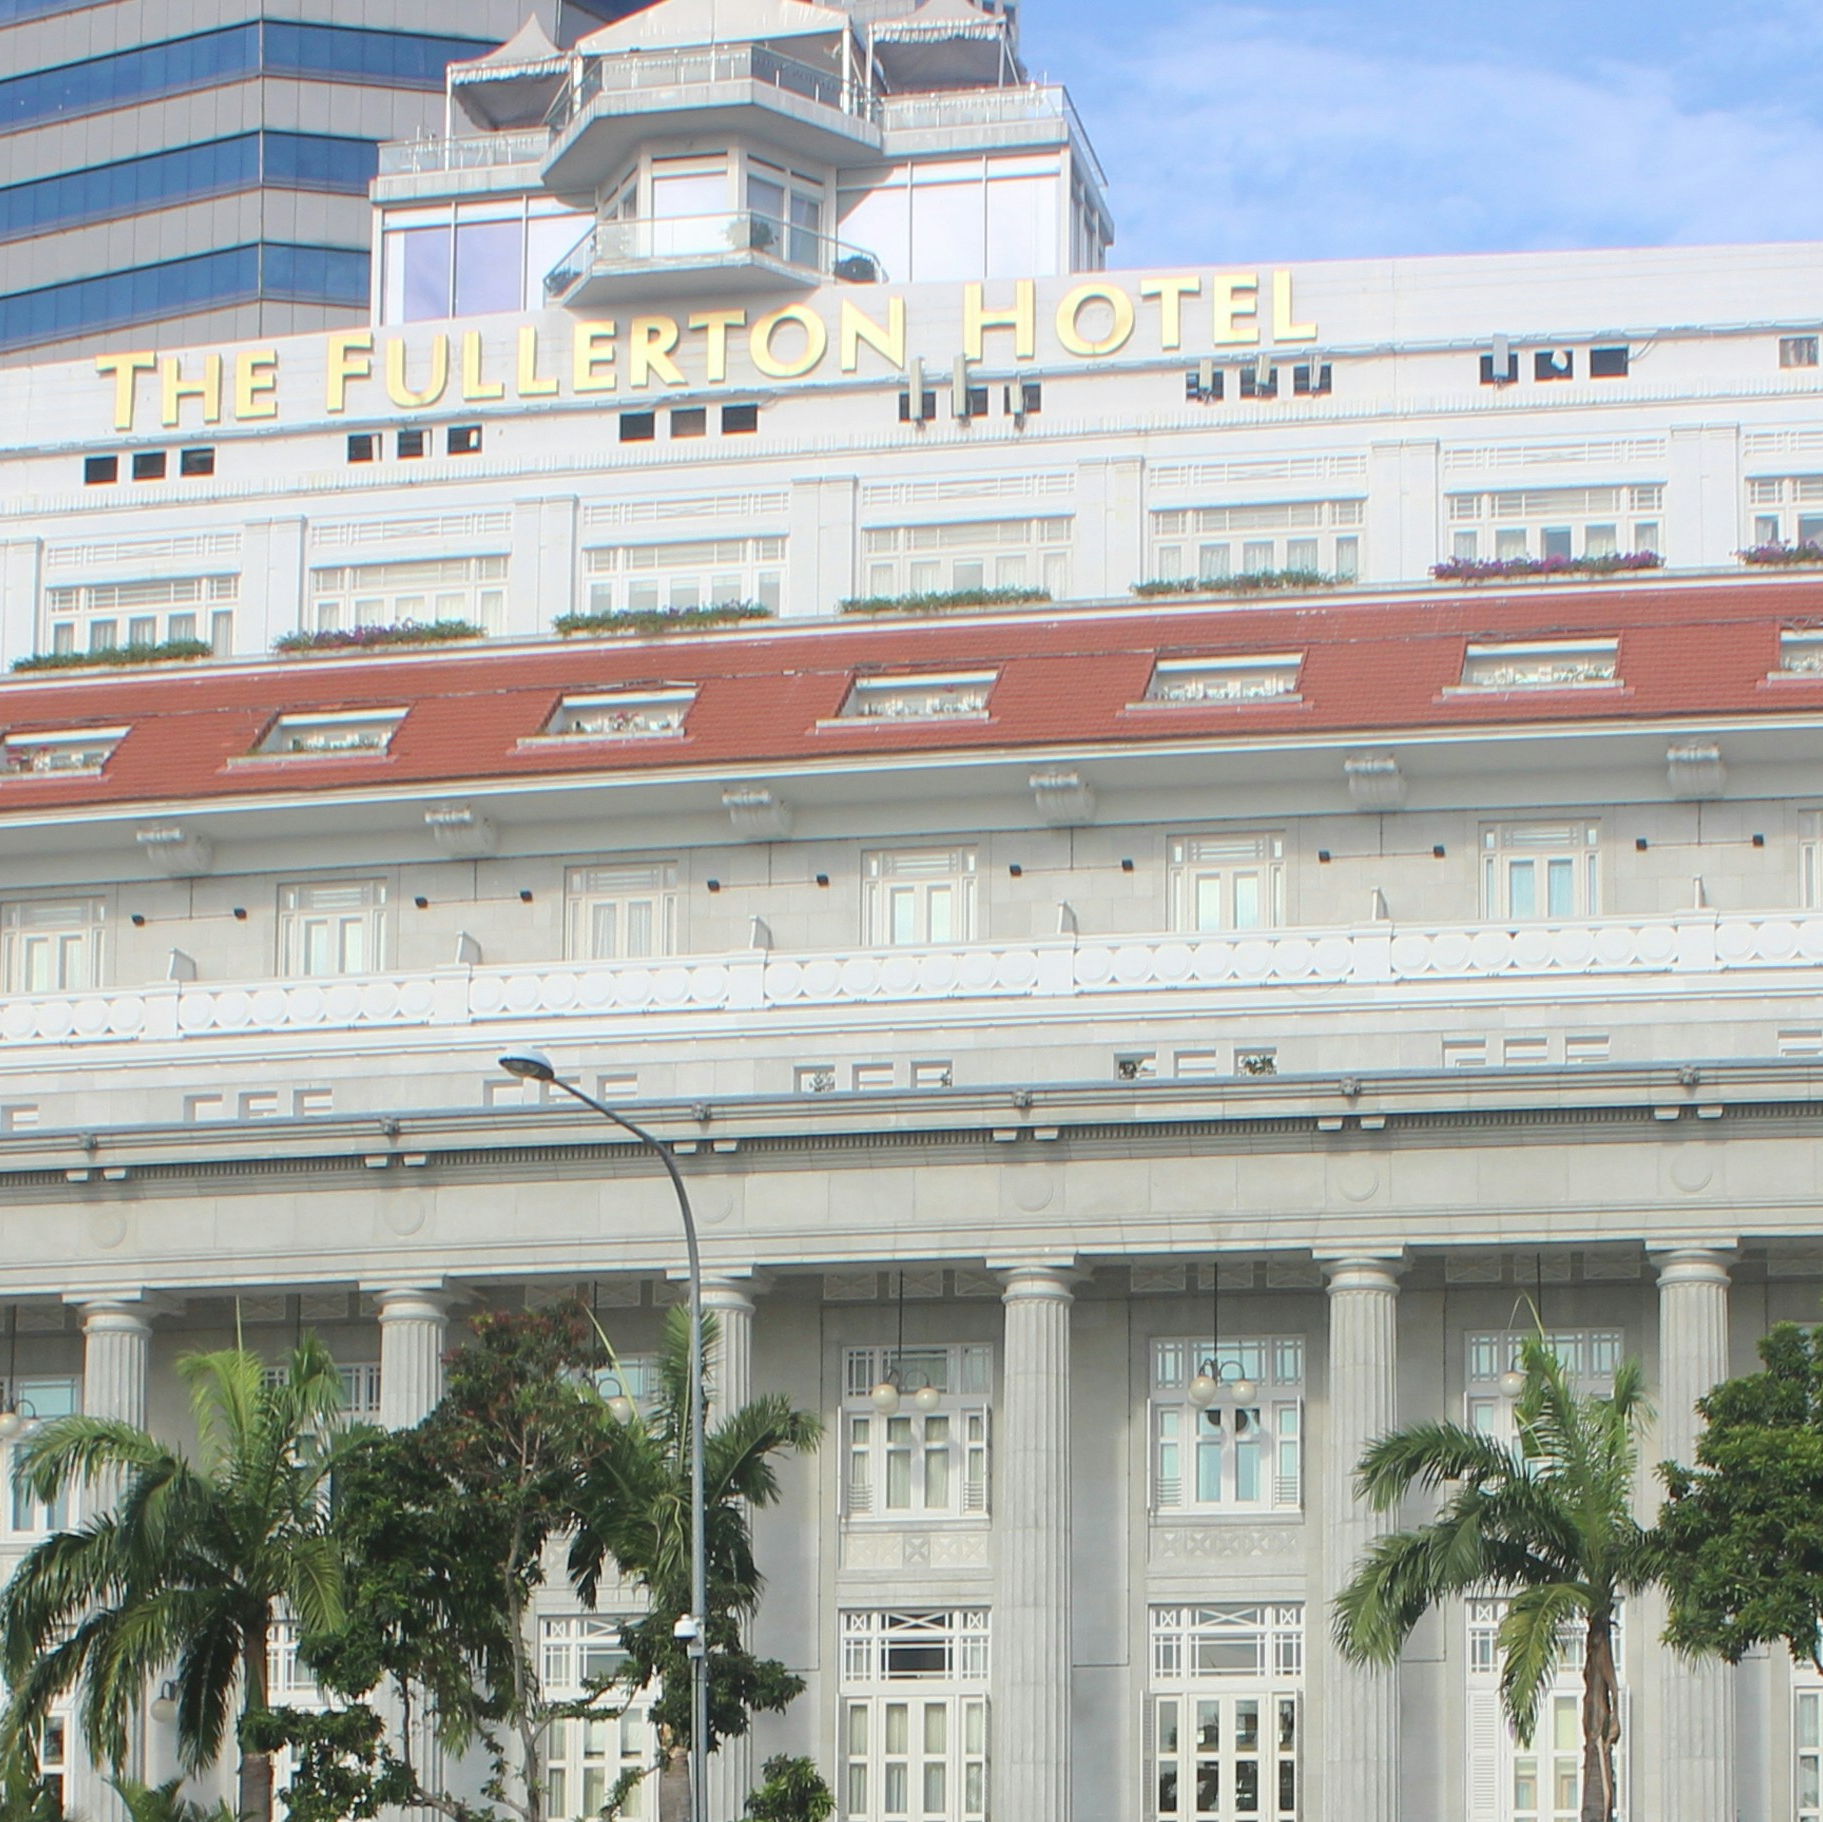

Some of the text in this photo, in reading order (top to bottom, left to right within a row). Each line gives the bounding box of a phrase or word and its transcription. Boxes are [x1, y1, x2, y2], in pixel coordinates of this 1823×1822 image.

[97, 268, 1318, 431] THE FULLERTON HOTEL
